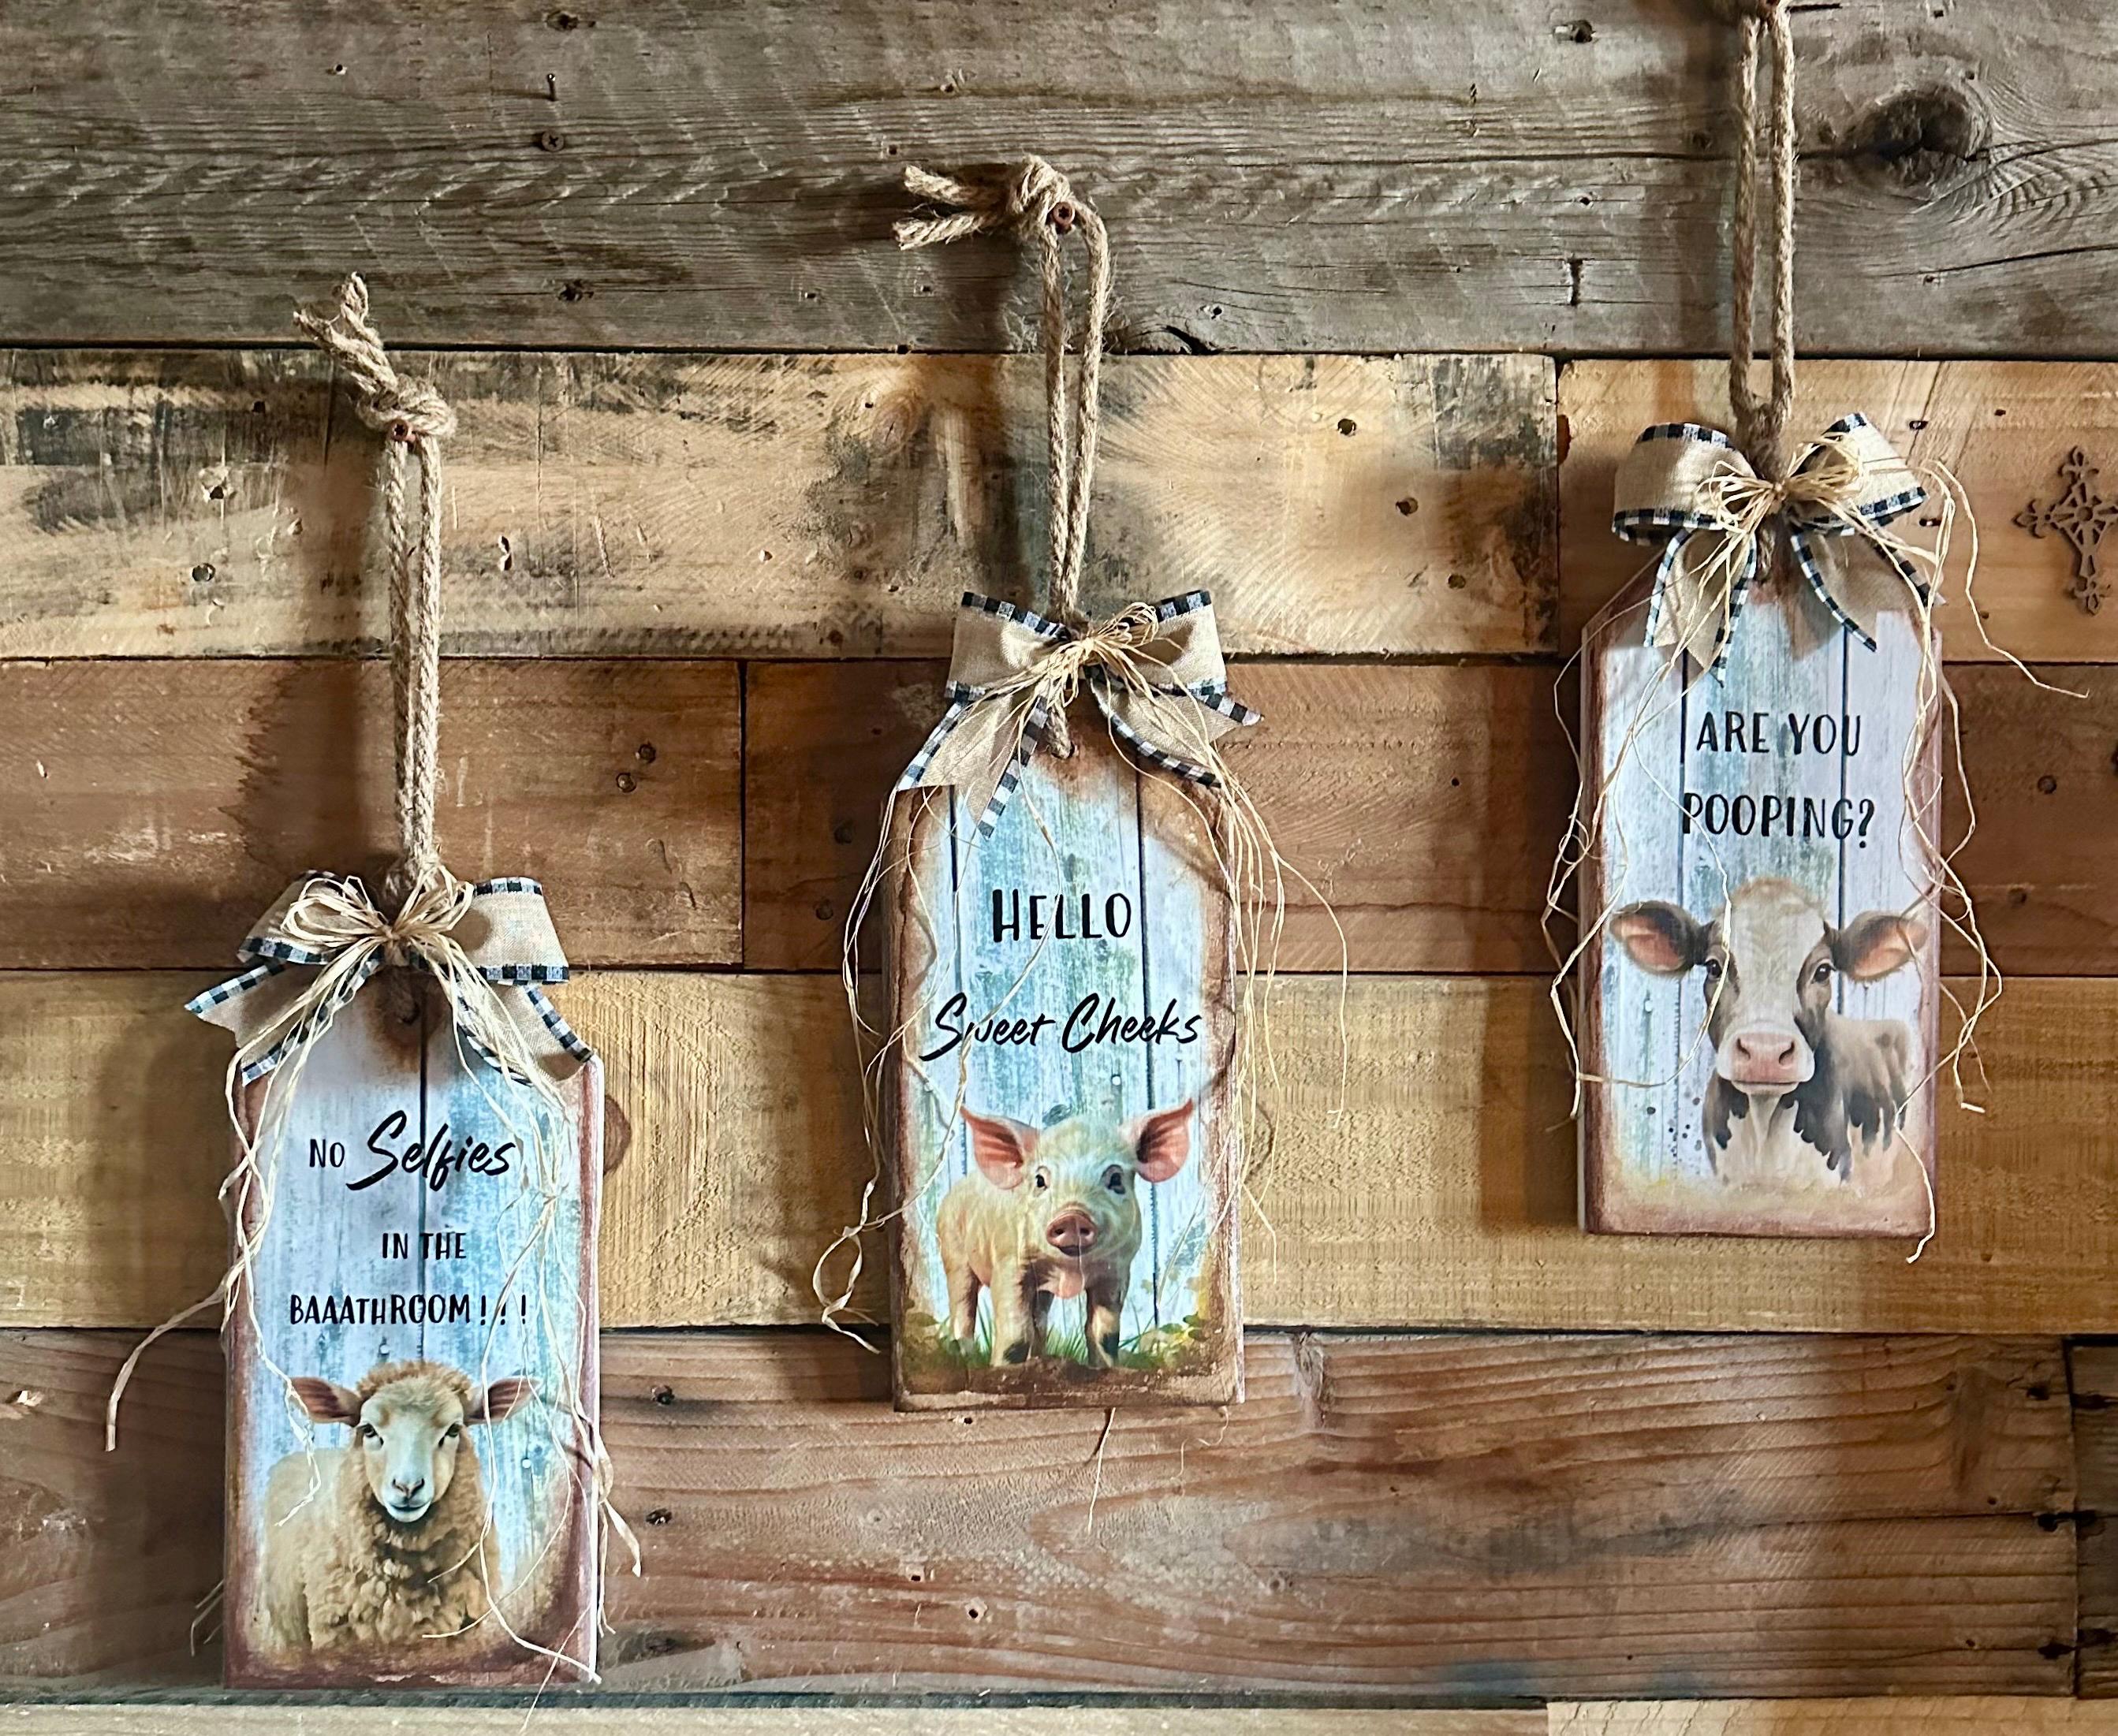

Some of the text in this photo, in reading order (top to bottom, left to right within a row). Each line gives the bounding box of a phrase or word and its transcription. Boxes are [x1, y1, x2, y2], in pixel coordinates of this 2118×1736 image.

[1696, 710, 1861, 757] ARE YOU
[1682, 792, 1875, 849] POOPING?
[992, 888, 1132, 943] HELLO
[919, 992, 1203, 1062] Sweet Cheeks
[309, 1109, 516, 1192] NO Selfies
[381, 1232, 467, 1261] IN THE
